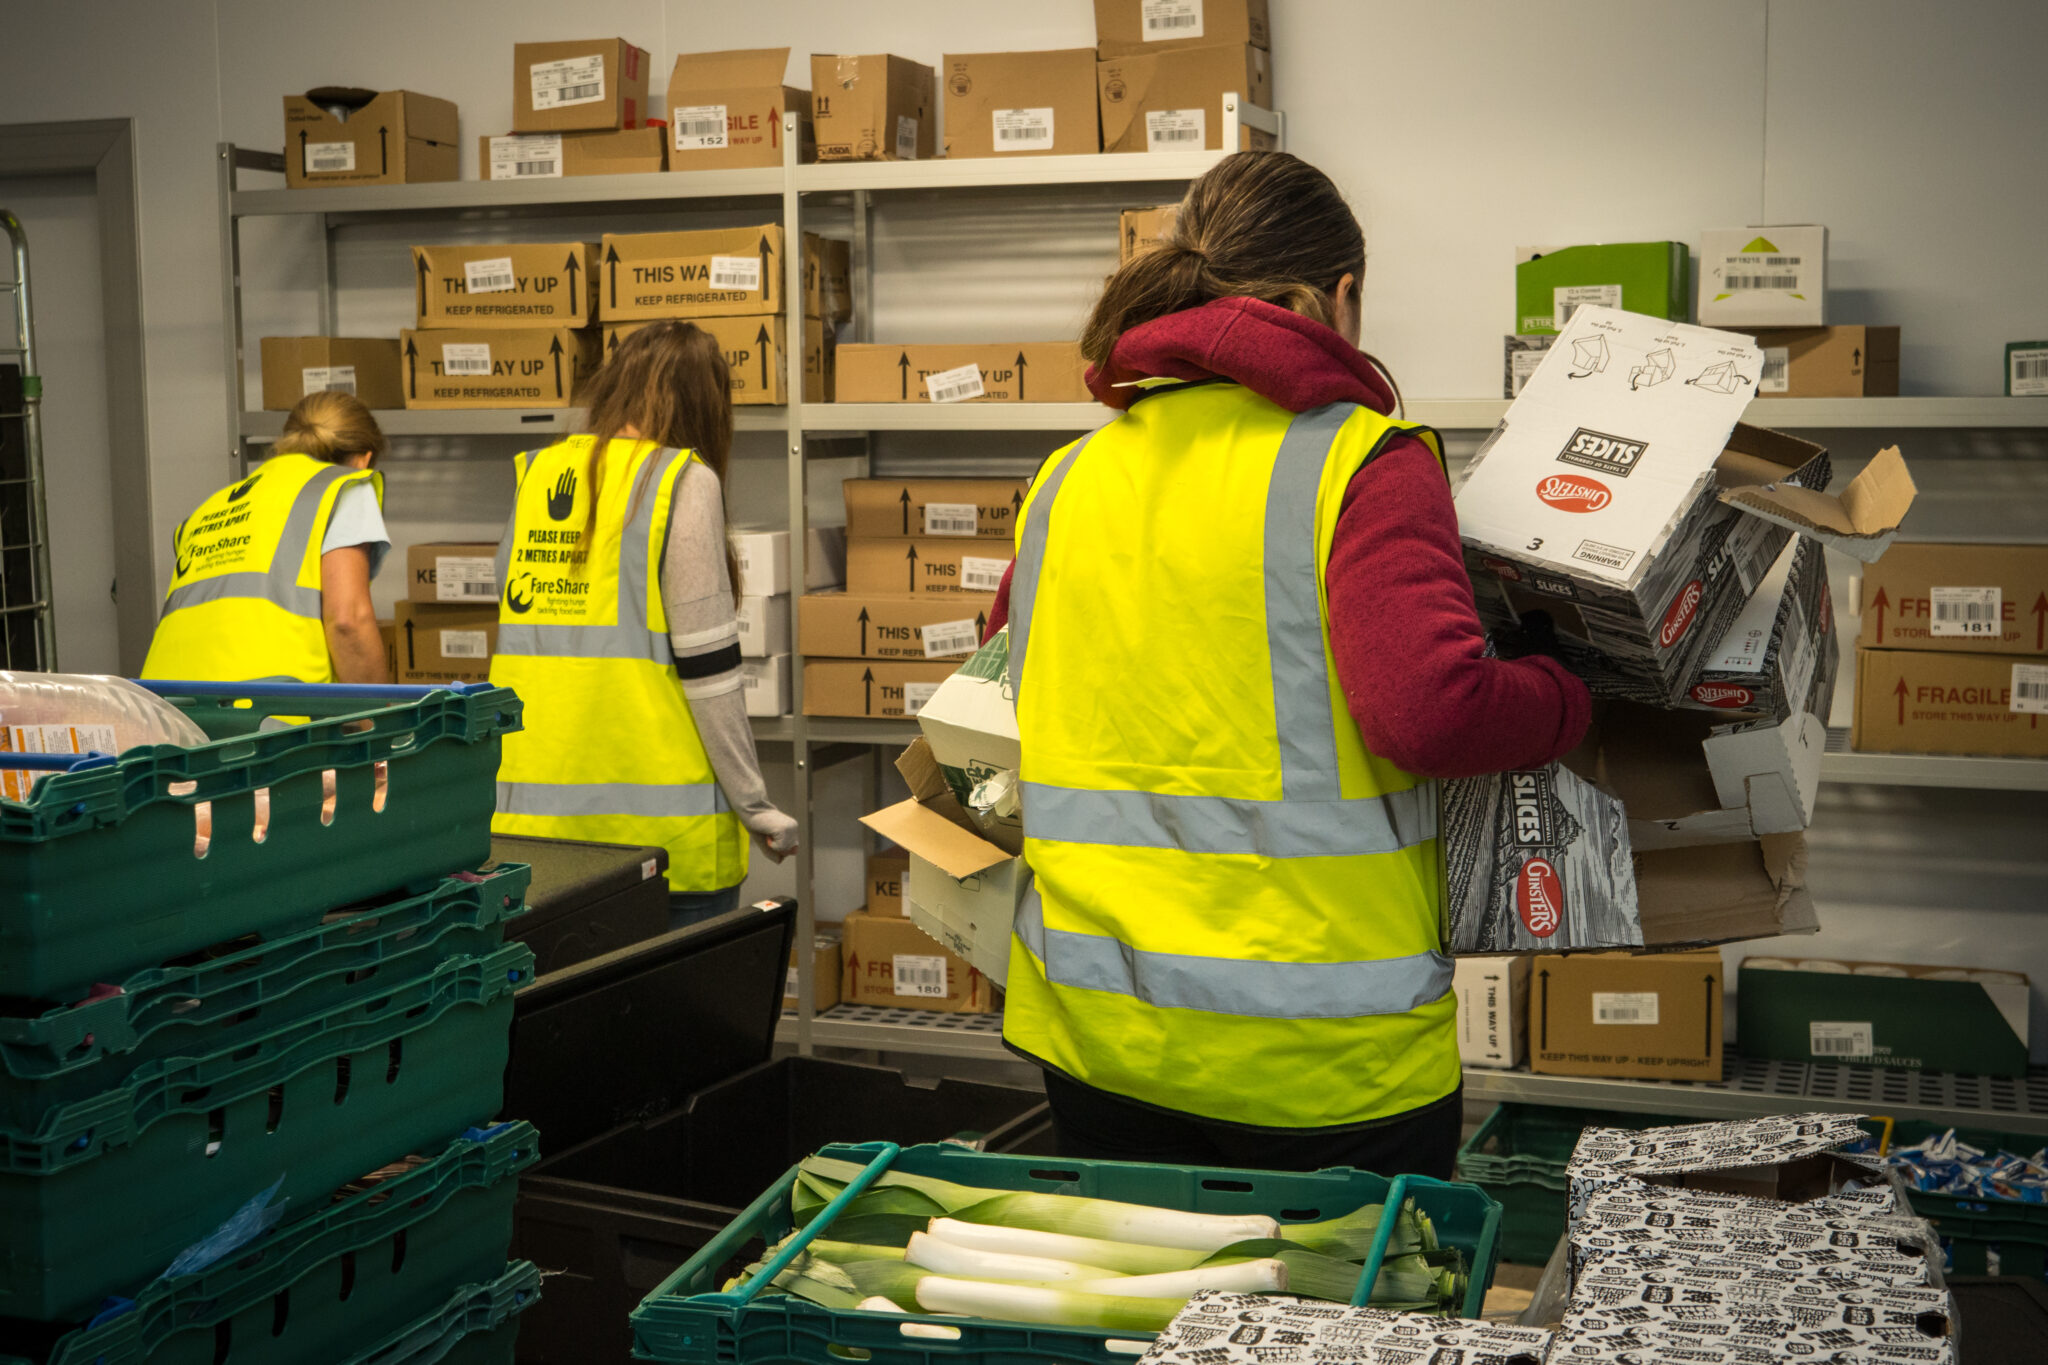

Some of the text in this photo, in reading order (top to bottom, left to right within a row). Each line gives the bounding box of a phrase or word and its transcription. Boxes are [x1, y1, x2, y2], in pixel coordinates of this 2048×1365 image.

[726, 115, 759, 130] GILE
[699, 137, 724, 145] 152
[732, 136, 763, 144] WAY UP
[828, 146, 850, 154] ASDA
[632, 264, 711, 284] THIS WA
[533, 277, 558, 293] UP
[635, 292, 748, 306] KEEP REFRIGERATED
[445, 304, 554, 316] KEEP REFRIGERATED
[492, 360, 544, 376] AY UP
[992, 370, 1013, 382] UP
[434, 388, 541, 398] KEEP REFRIGERATED
[1570, 434, 1641, 464] SLICES
[1540, 477, 1609, 510] GINSTERS
[990, 508, 1010, 520] UP
[528, 530, 582, 544] PLEASE KEEP
[1526, 538, 1544, 552] 3
[517, 549, 590, 564] 2 METRES APART
[1580, 552, 1621, 568] WARNING
[416, 569, 437, 584] KE
[924, 564, 956, 576] THIS
[926, 584, 948, 592] KEEP
[1536, 580, 1572, 596] SLICES
[1660, 584, 1700, 644] GINSTERS
[876, 626, 910, 640] THIS
[1960, 623, 1993, 633] 181
[2004, 632, 2022, 643] UP
[878, 648, 900, 656] KEEP
[881, 686, 904, 699] THI
[1696, 686, 1750, 704] GINSTERS
[1916, 686, 2011, 705] FRAGILE
[1912, 711, 2018, 723] STORE THIS WAY UP
[1512, 774, 1541, 843] SLICES
[1543, 800, 1549, 808] OF
[1544, 810, 1552, 842] CORNWALL
[875, 881, 898, 896] KE
[1526, 861, 1558, 932] GINSTERS
[916, 986, 942, 994] 180
[1487, 986, 1498, 1048] THIS WAY UP
[1540, 1053, 1712, 1068] KEEP THIS WAY UP KEEP UPRIGHT
[1883, 1056, 1922, 1068] SAUCES
